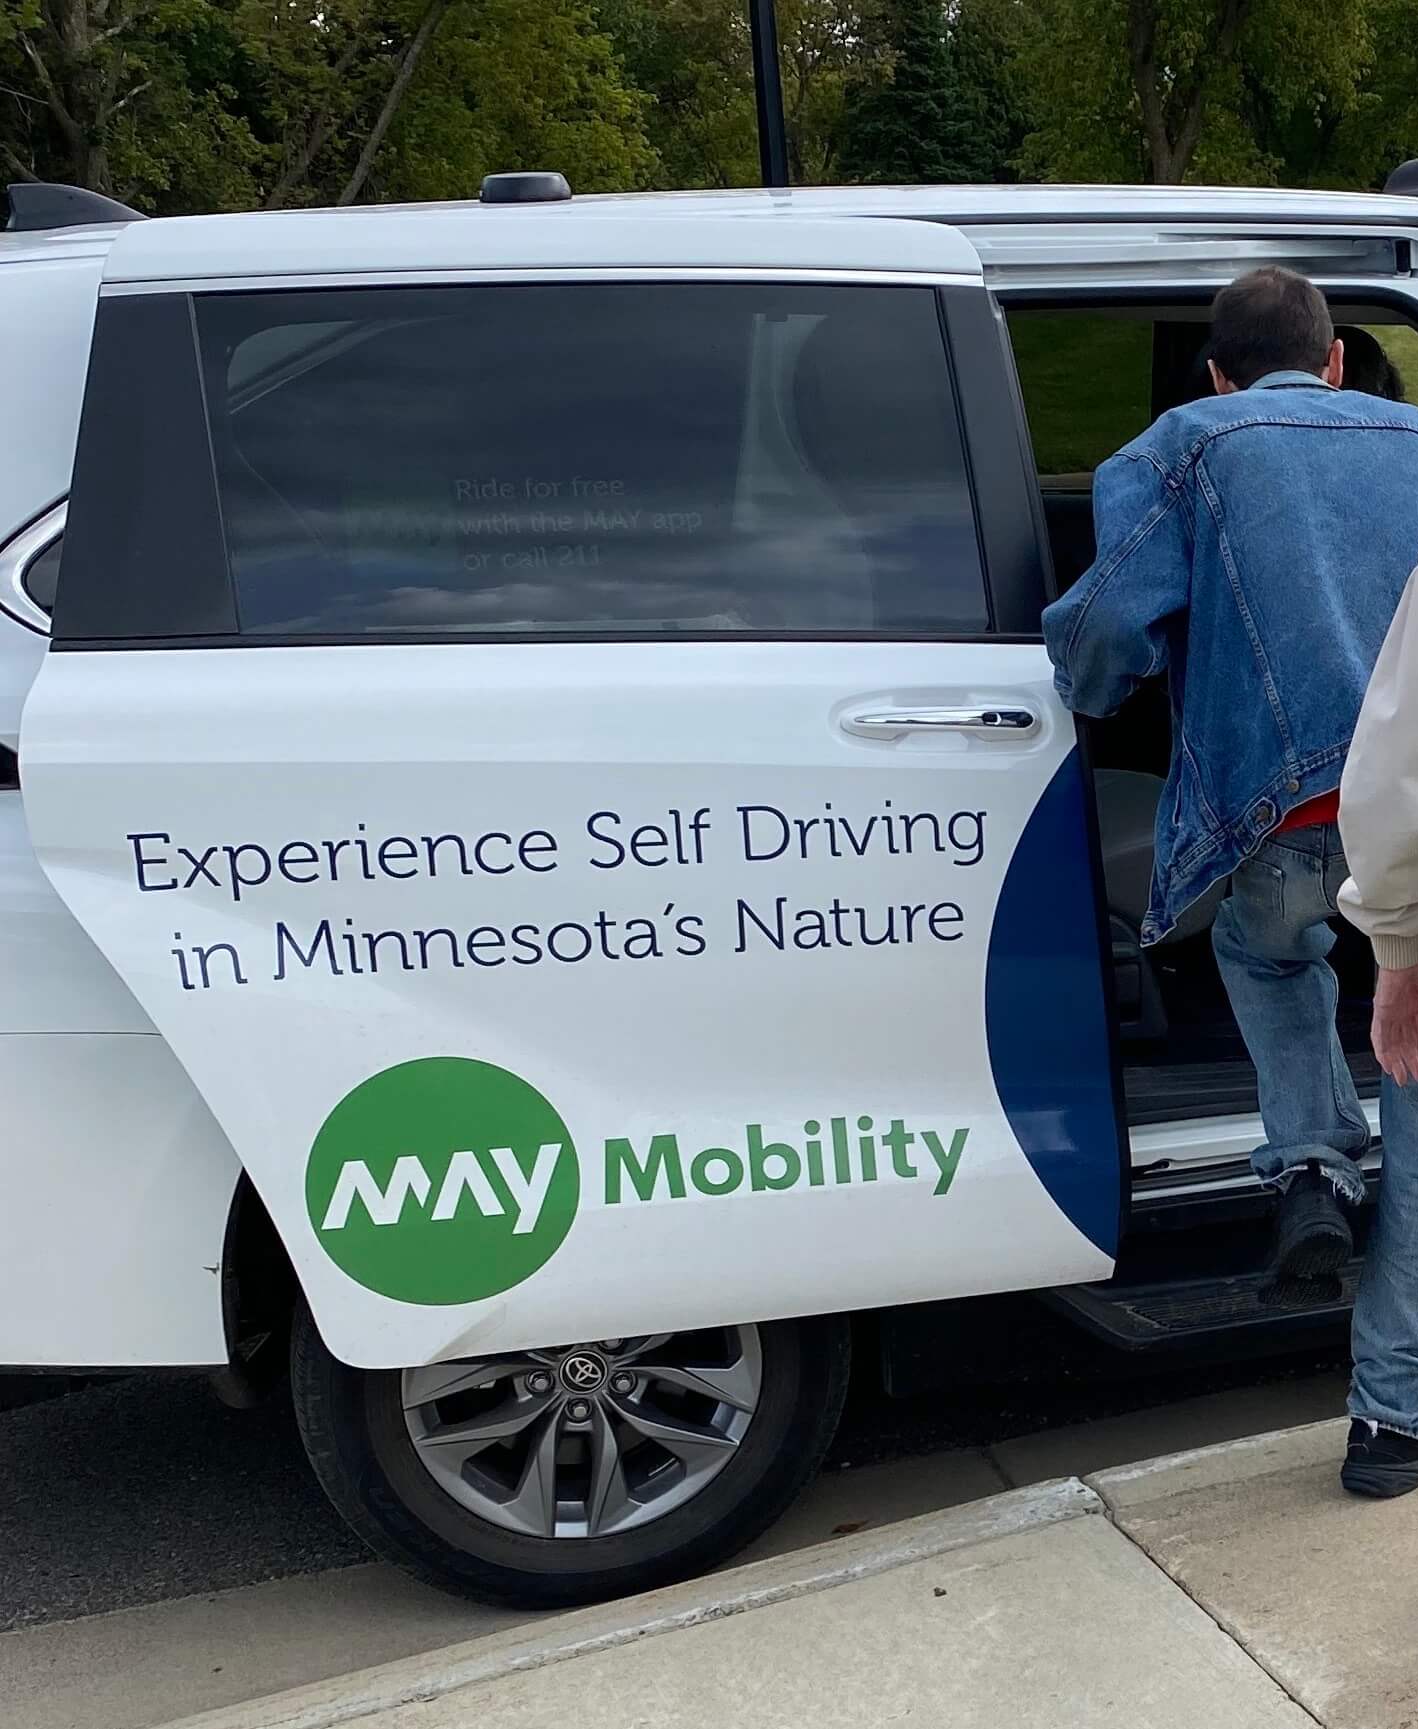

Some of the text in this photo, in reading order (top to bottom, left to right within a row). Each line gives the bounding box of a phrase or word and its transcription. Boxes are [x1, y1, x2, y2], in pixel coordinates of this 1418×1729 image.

[457, 474, 625, 498] Ride for free
[530, 509, 572, 534] the
[583, 509, 640, 531] MAY
[653, 511, 702, 536] app
[463, 552, 491, 571] or
[503, 545, 549, 569] call
[127, 799, 988, 902] Experience Self Driving
[172, 896, 964, 990] in Minnesota's Nature
[604, 1115, 970, 1205] Mobility
